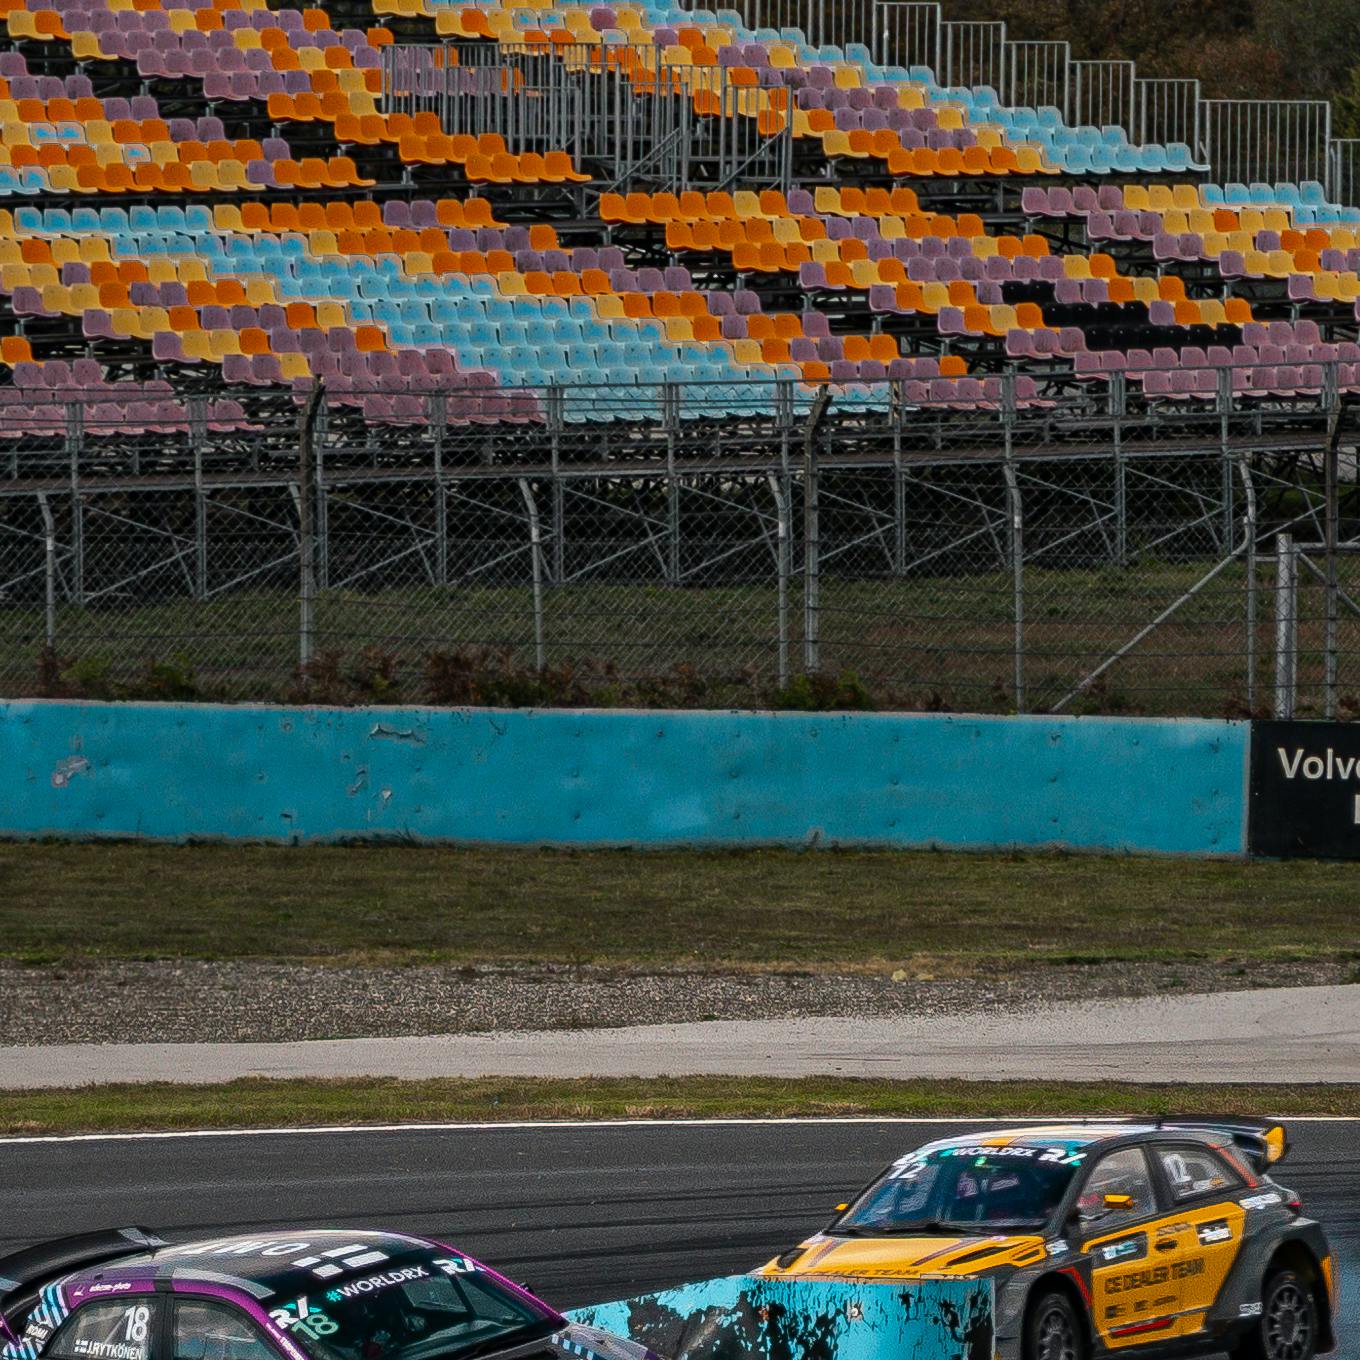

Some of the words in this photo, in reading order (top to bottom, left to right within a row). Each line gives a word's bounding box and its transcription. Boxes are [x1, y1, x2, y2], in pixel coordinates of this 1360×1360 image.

[431, 1257, 486, 1275] RX
[326, 1266, 429, 1302] #WORLDRX
[125, 1306, 150, 1342] 18
[267, 1296, 322, 1329] RX
[291, 1314, 339, 1341] 18
